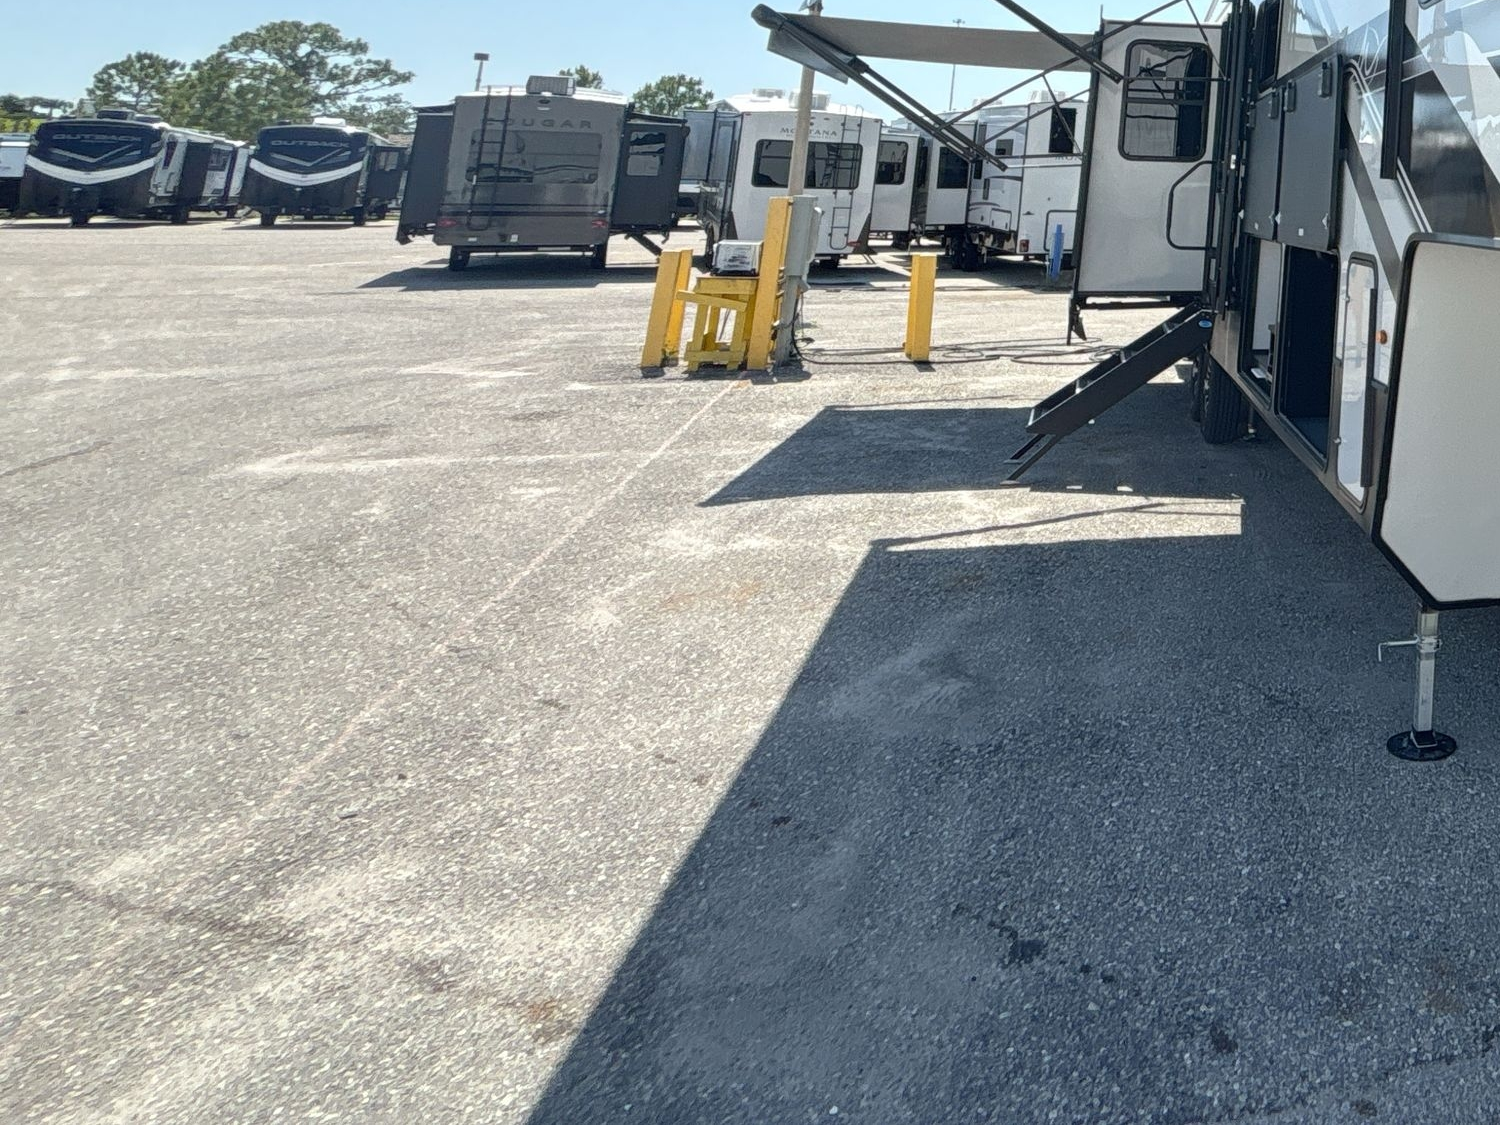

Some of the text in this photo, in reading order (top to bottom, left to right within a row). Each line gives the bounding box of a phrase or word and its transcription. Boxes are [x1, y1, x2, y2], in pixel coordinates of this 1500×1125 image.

[780, 127, 837, 136] MOTANA
[52, 133, 142, 142] OUTBACK
[271, 139, 350, 148] OUTBACK
